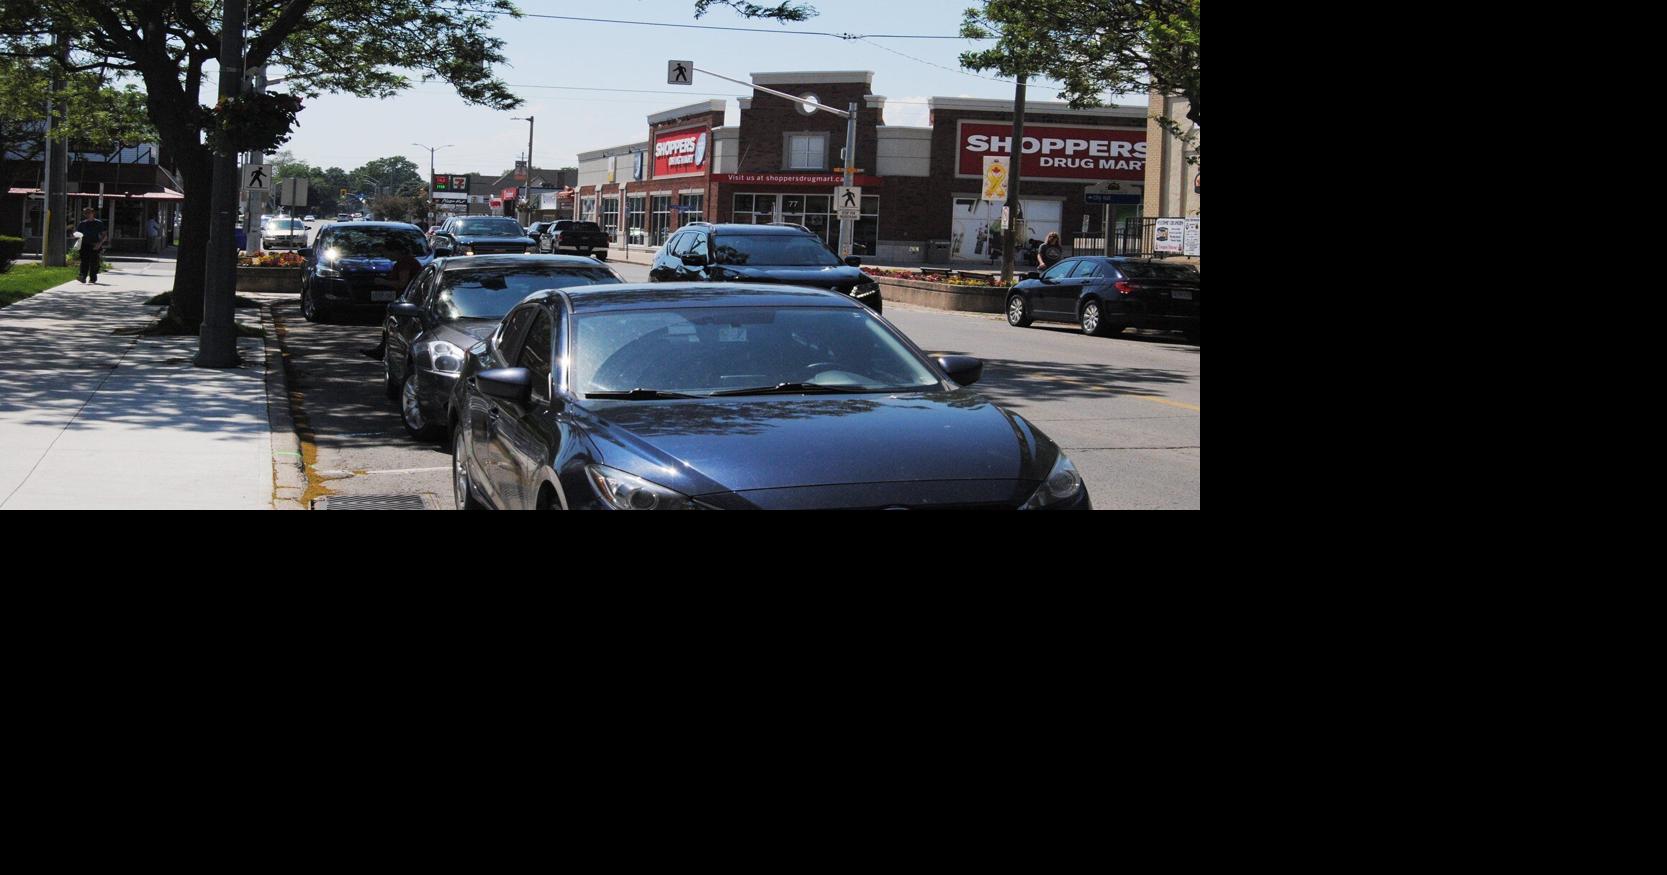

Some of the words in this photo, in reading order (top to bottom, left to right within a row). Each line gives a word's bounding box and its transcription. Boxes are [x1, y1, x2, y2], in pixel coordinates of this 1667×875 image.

[655, 137, 697, 157] SHOPPERS
[966, 134, 1146, 158] SHOPPERS
[1039, 156, 1094, 169] DRUG
[765, 174, 845, 183] shoppersdrugmart.ca
